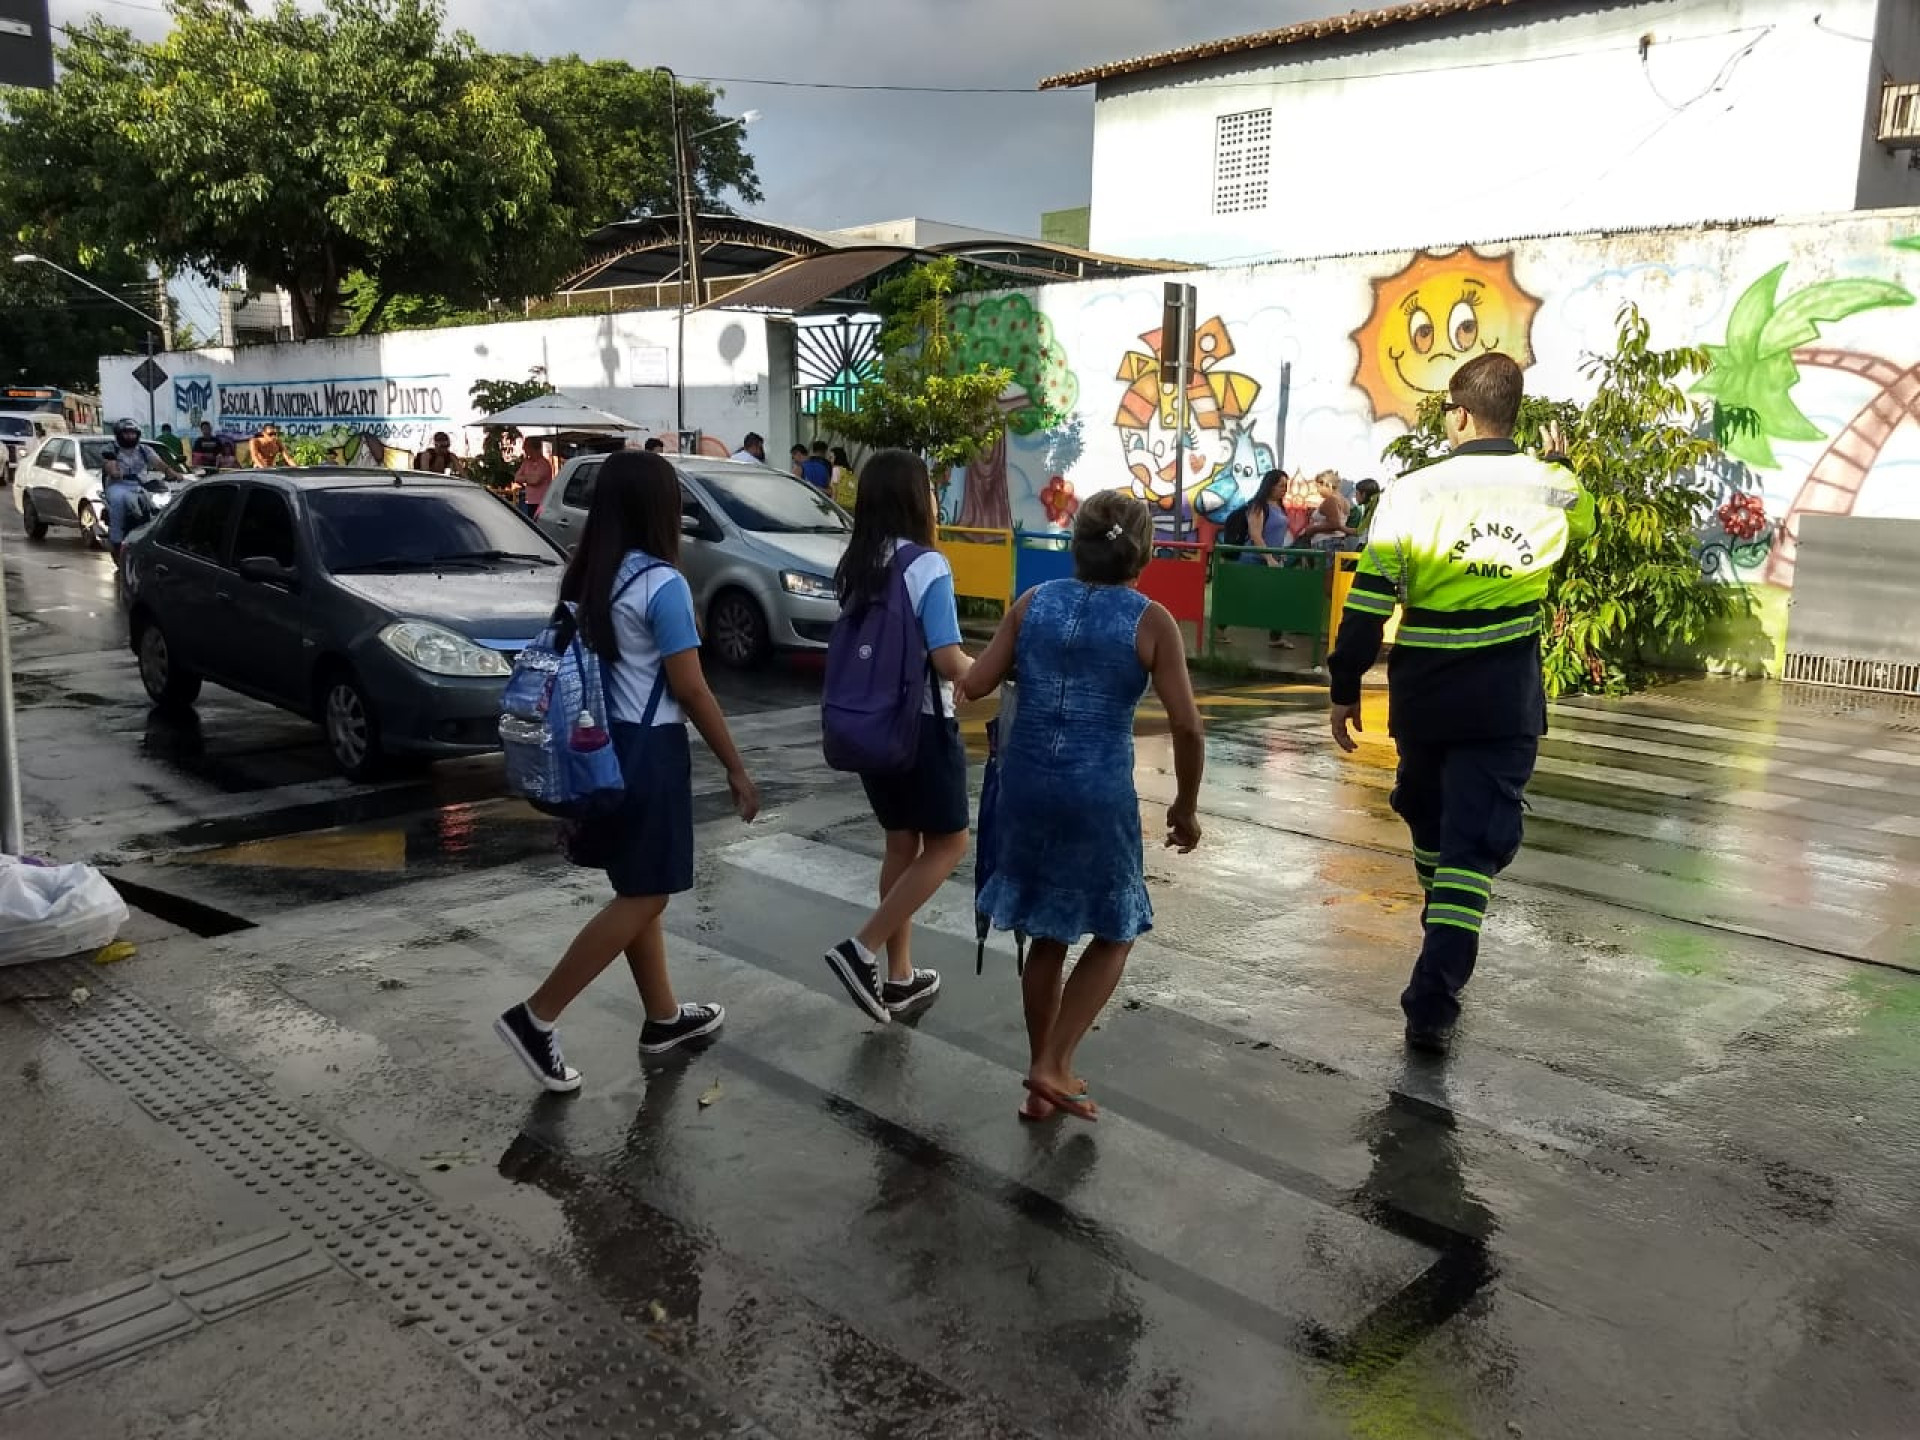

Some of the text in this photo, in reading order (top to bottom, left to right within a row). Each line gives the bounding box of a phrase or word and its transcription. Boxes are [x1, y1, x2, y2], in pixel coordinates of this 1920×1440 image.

[219, 379, 442, 417] ESCOLA MUNICIPAL MOZART PINTO
[1464, 562, 1513, 580] AMC
